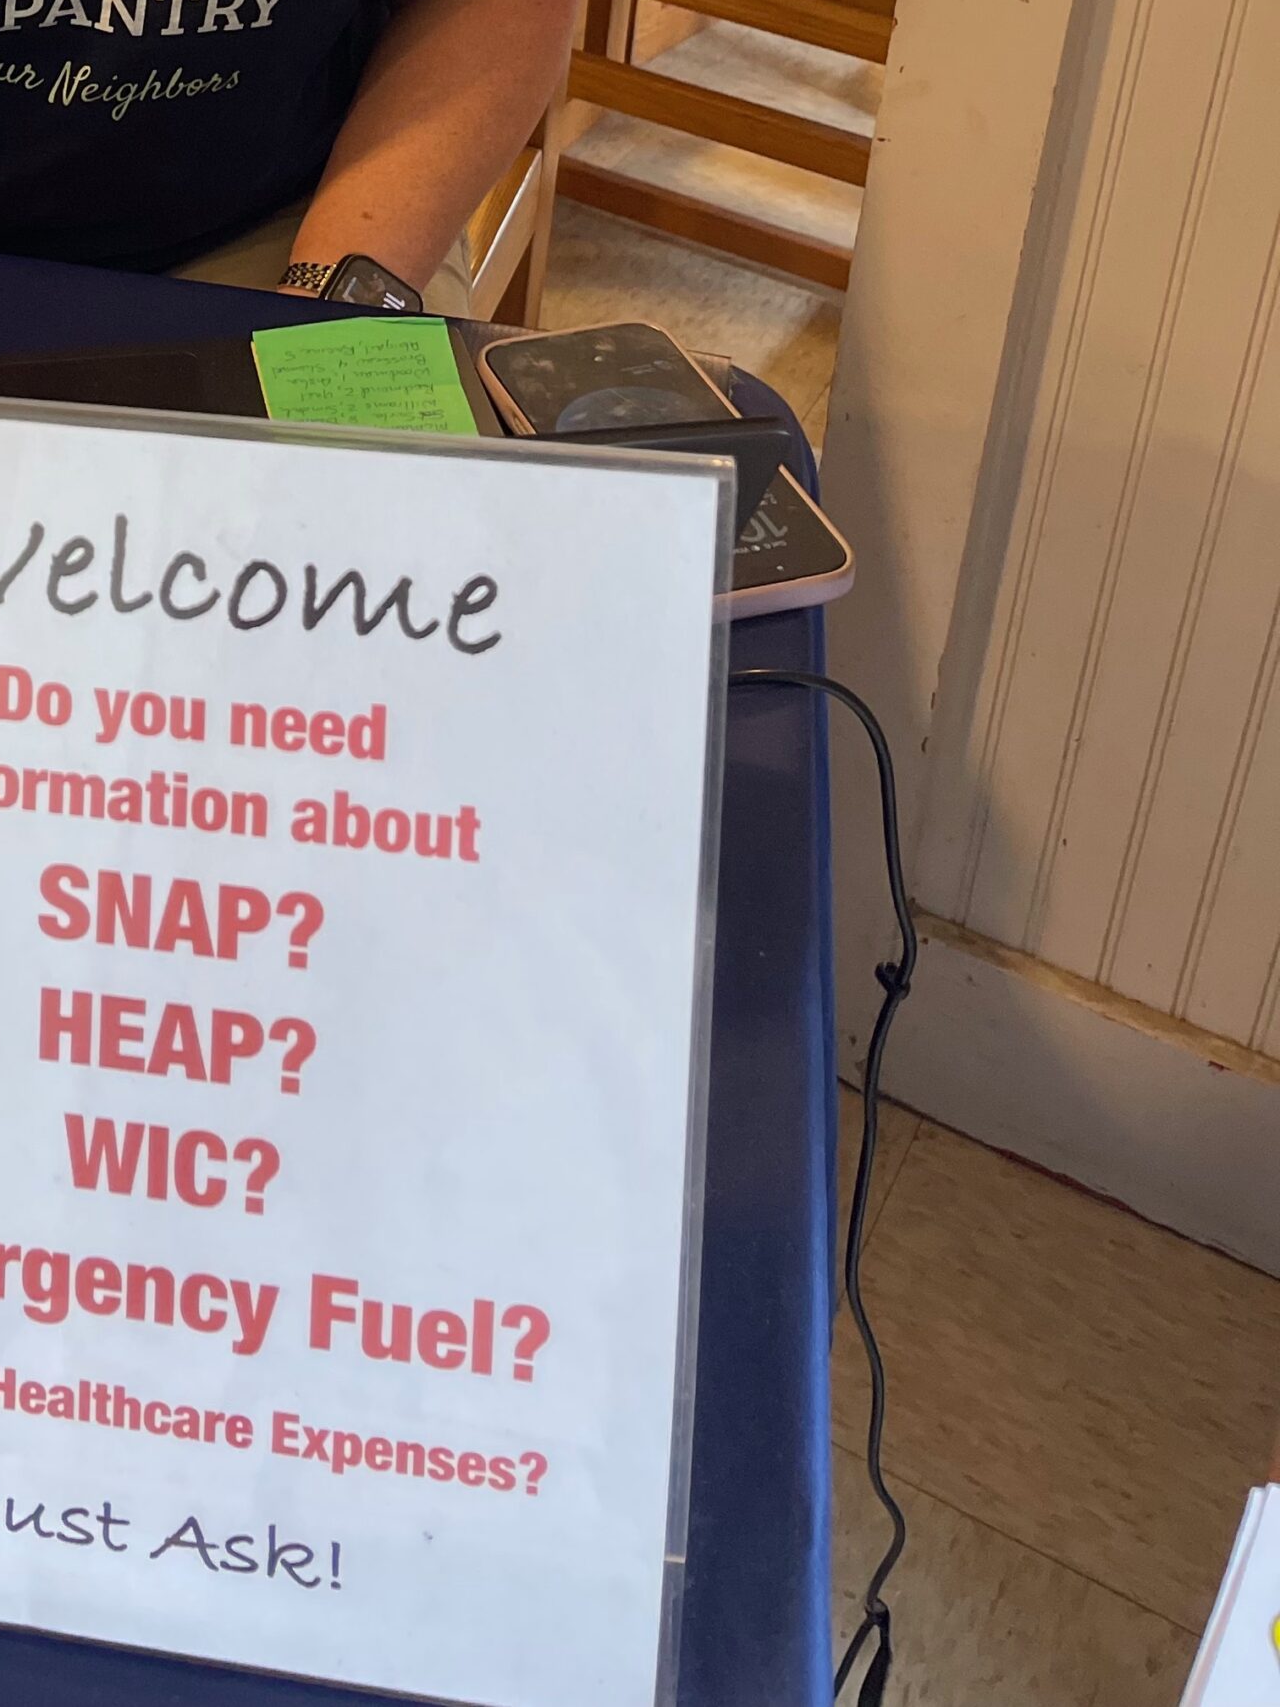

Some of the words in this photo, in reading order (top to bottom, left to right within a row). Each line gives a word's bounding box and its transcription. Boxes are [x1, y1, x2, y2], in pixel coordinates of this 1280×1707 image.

[48, 61, 241, 121] Neighbors
[94, 686, 206, 745] you
[230, 697, 387, 761] need
[291, 789, 481, 863] about
[37, 863, 326, 969] SNAP?
[39, 987, 317, 1095] HEAP?
[64, 1112, 281, 1215] WIC?
[308, 1274, 551, 1383] Fuel?
[271, 1412, 549, 1497] Expenses?
[149, 1517, 342, 1592] Ask!
